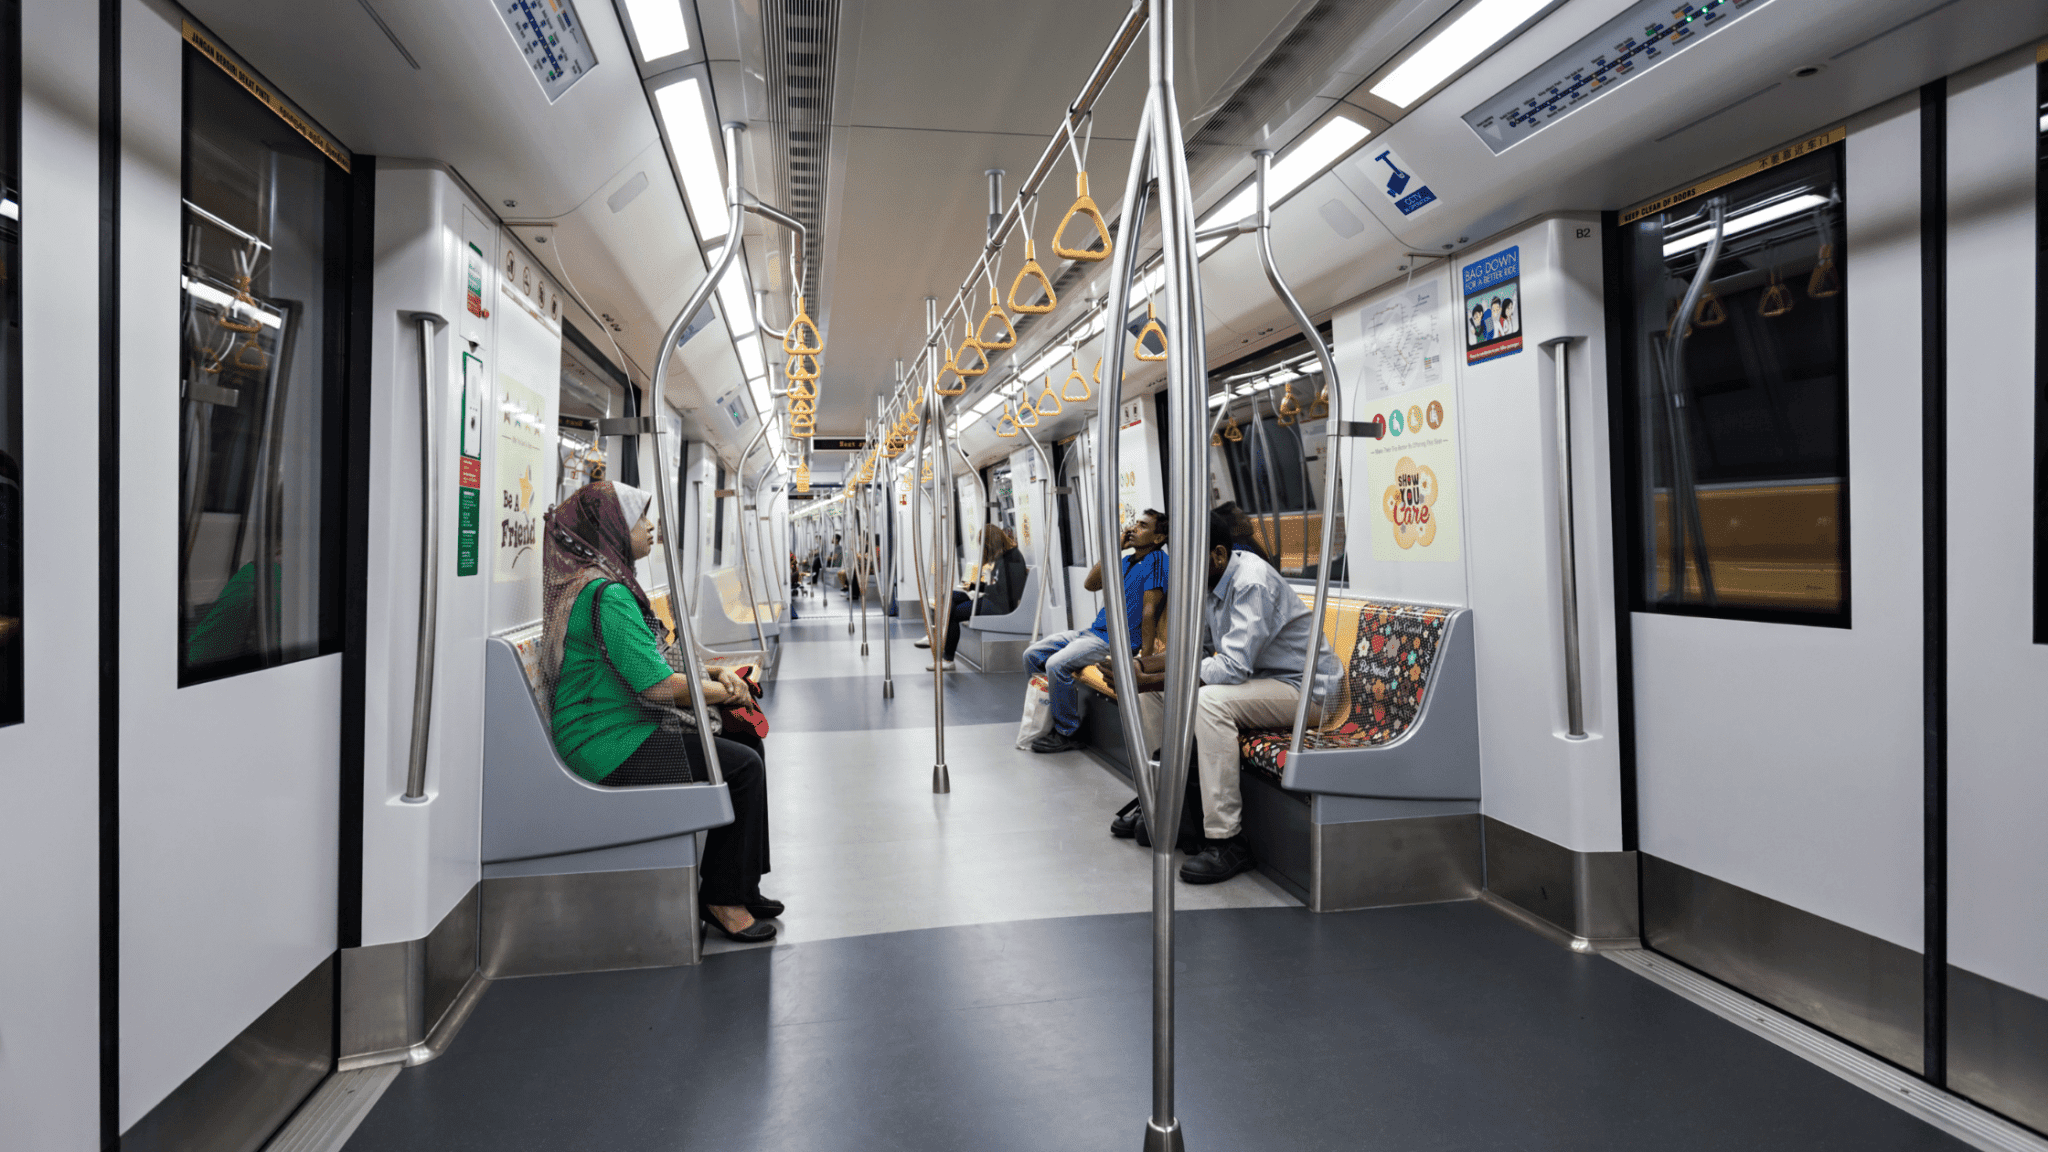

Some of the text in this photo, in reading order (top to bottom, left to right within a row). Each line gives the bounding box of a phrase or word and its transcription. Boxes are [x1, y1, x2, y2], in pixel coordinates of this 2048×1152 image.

[1404, 192, 1422, 206] CCTV
[1624, 187, 1696, 222] KEEP CLEAR OF DOORS
[1576, 228, 1591, 239] B2
[1464, 250, 1517, 283] BAG DOWN
[1465, 280, 1477, 291] FOR
[1483, 270, 1503, 284] BETTER
[1503, 264, 1517, 277] RIDE
[1398, 473, 1419, 487] SHOW
[503, 489, 520, 512] Be A
[1400, 486, 1420, 506] YOU
[1393, 504, 1430, 527] Care
[501, 517, 536, 548] Friend
